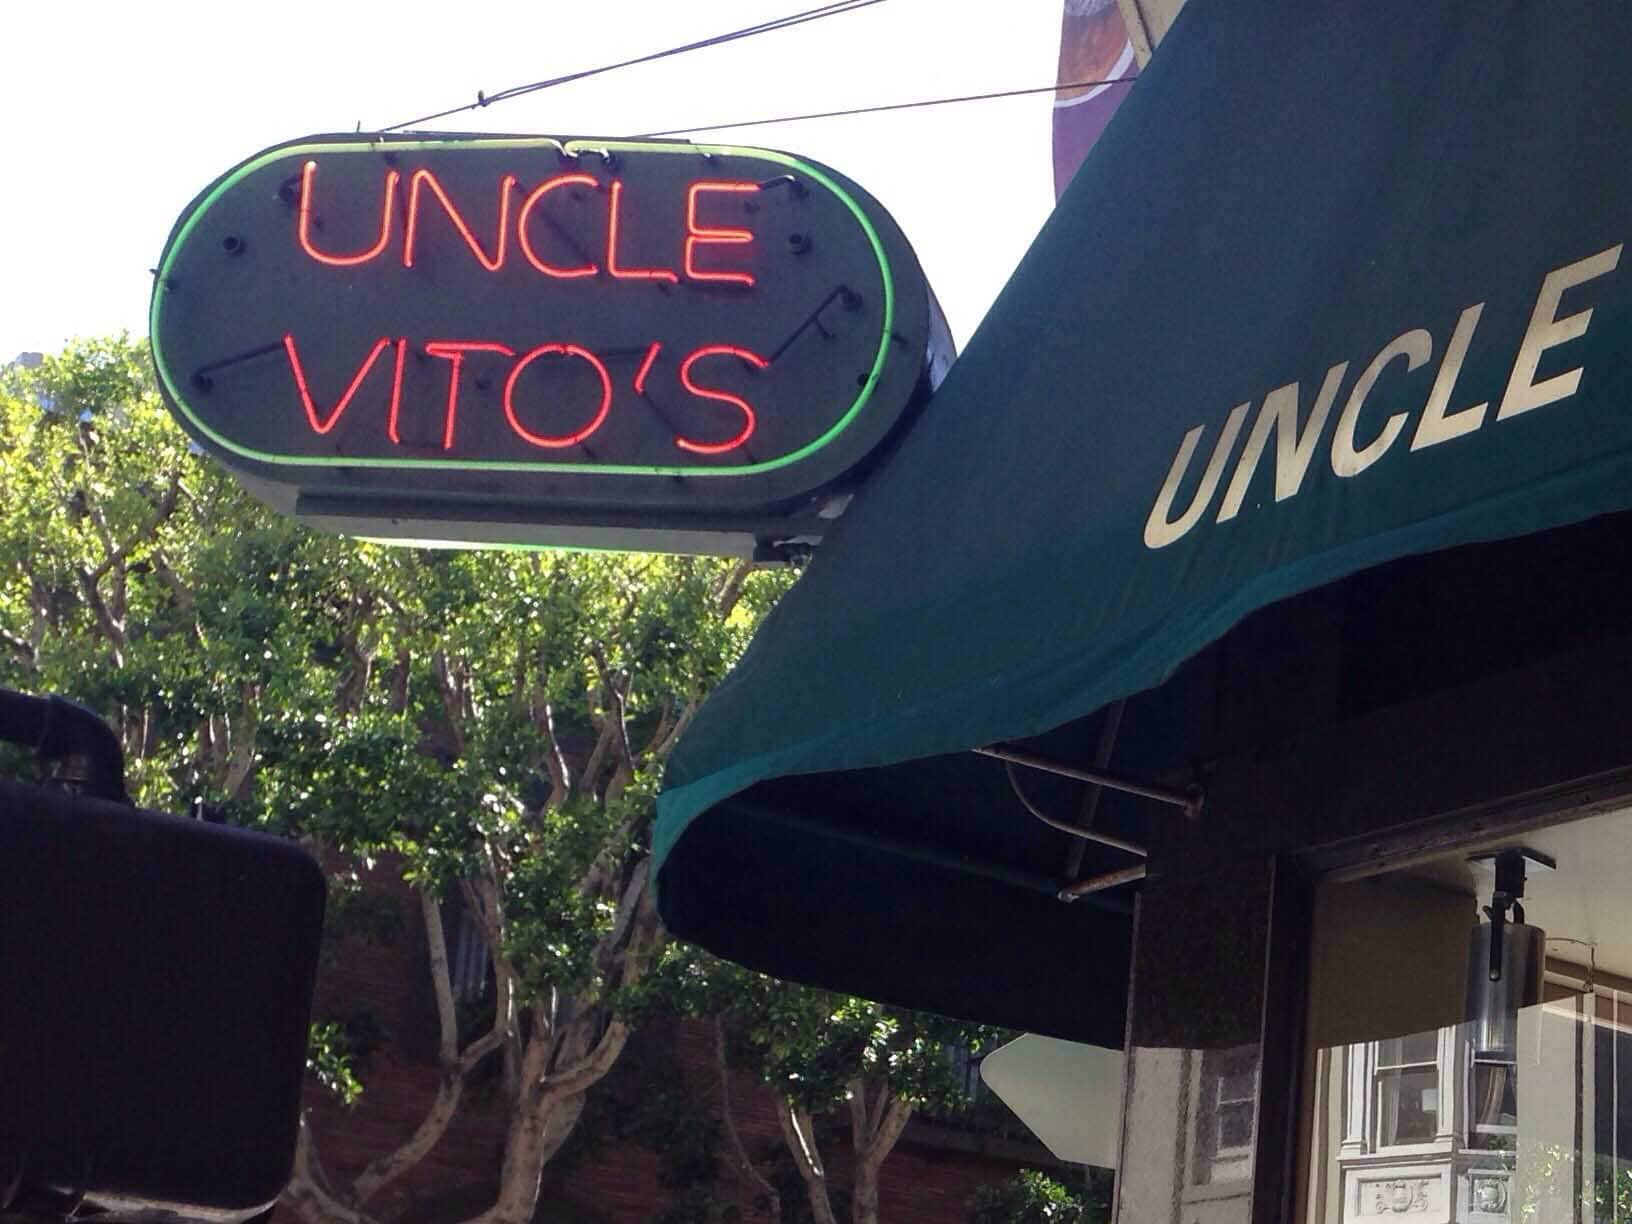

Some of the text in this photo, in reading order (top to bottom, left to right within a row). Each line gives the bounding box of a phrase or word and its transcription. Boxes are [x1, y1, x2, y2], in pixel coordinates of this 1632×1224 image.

[299, 160, 758, 288] UNCLE
[283, 333, 769, 454] VITO'S
[1143, 242, 1624, 551] UNCLE
